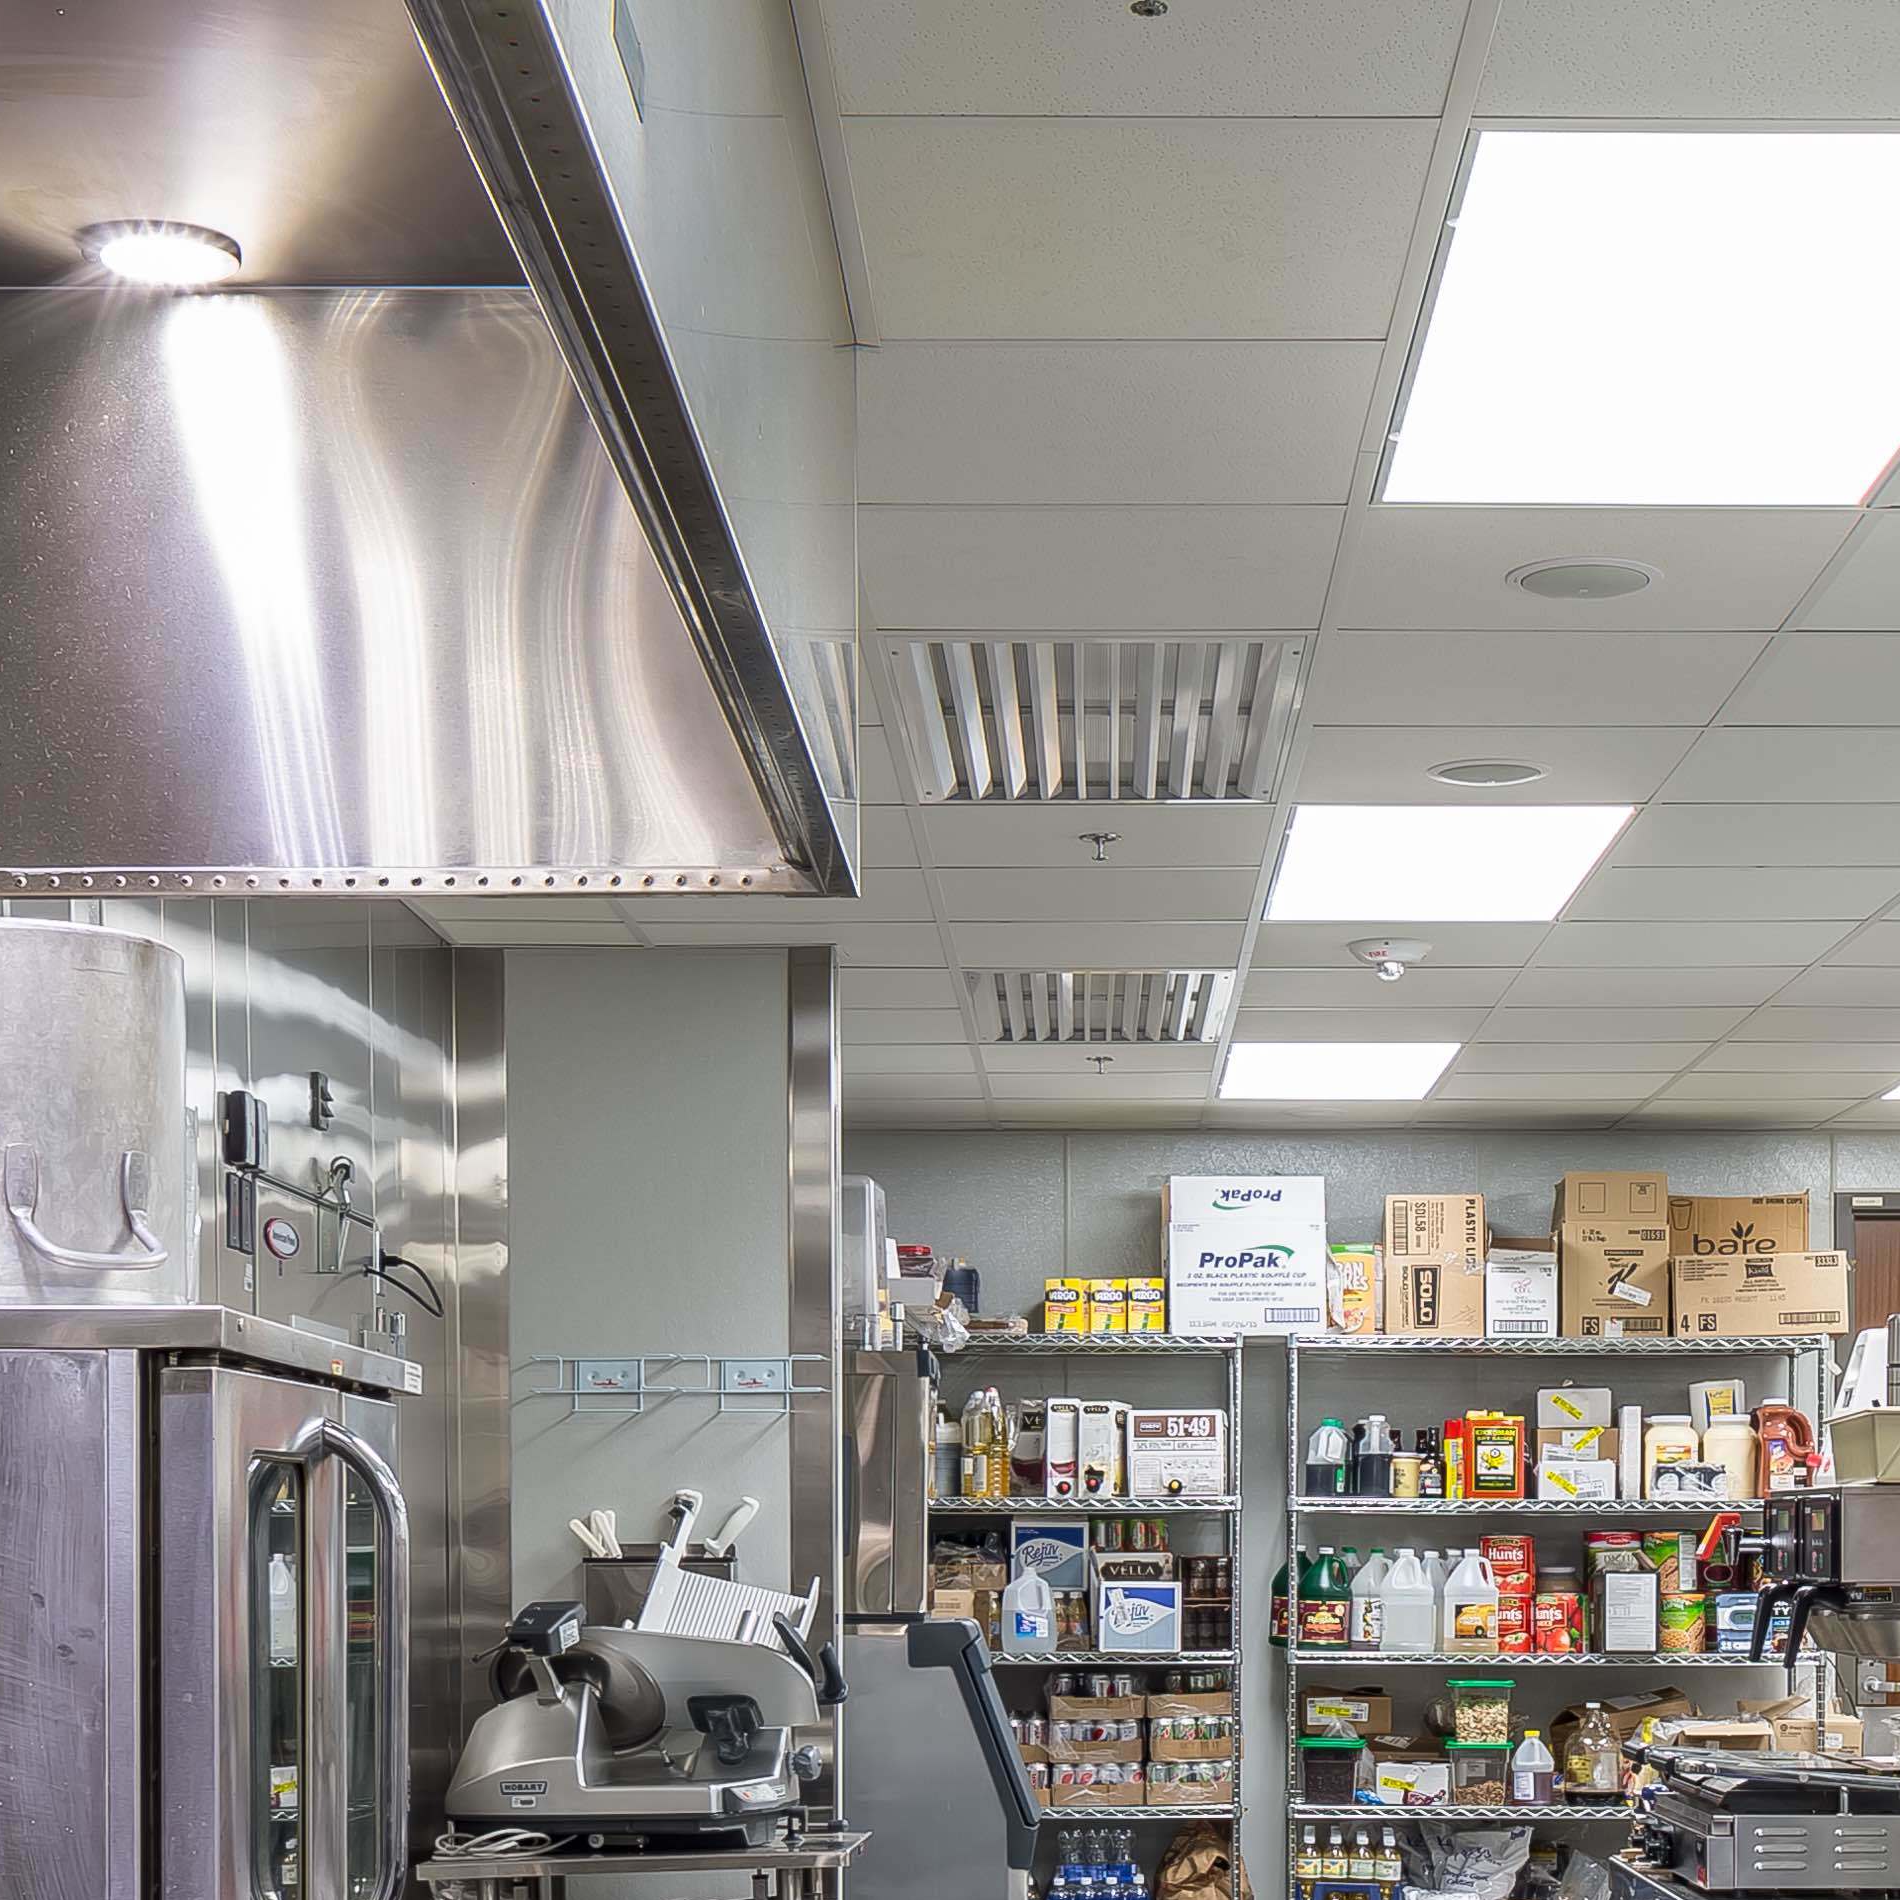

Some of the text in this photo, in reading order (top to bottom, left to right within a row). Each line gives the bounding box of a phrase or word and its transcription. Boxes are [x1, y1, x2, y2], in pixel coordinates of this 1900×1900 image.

[1220, 1189, 1282, 1202] ProPak
[1465, 1198, 1477, 1243] PLASTIC
[1692, 1233, 1777, 1256] bare
[1199, 1252, 1280, 1268] ProPak
[1419, 1270, 1433, 1322] SOLO
[1583, 1317, 1598, 1333] FS
[1680, 1314, 1690, 1332] 4
[1699, 1314, 1716, 1332] FS
[1166, 1416, 1210, 1437] 51-49
[1488, 1549, 1524, 1561] Hunt's
[1109, 1565, 1155, 1576] VELLA
[1498, 1609, 1524, 1621] unt's
[503, 1783, 544, 1792] HOBART
